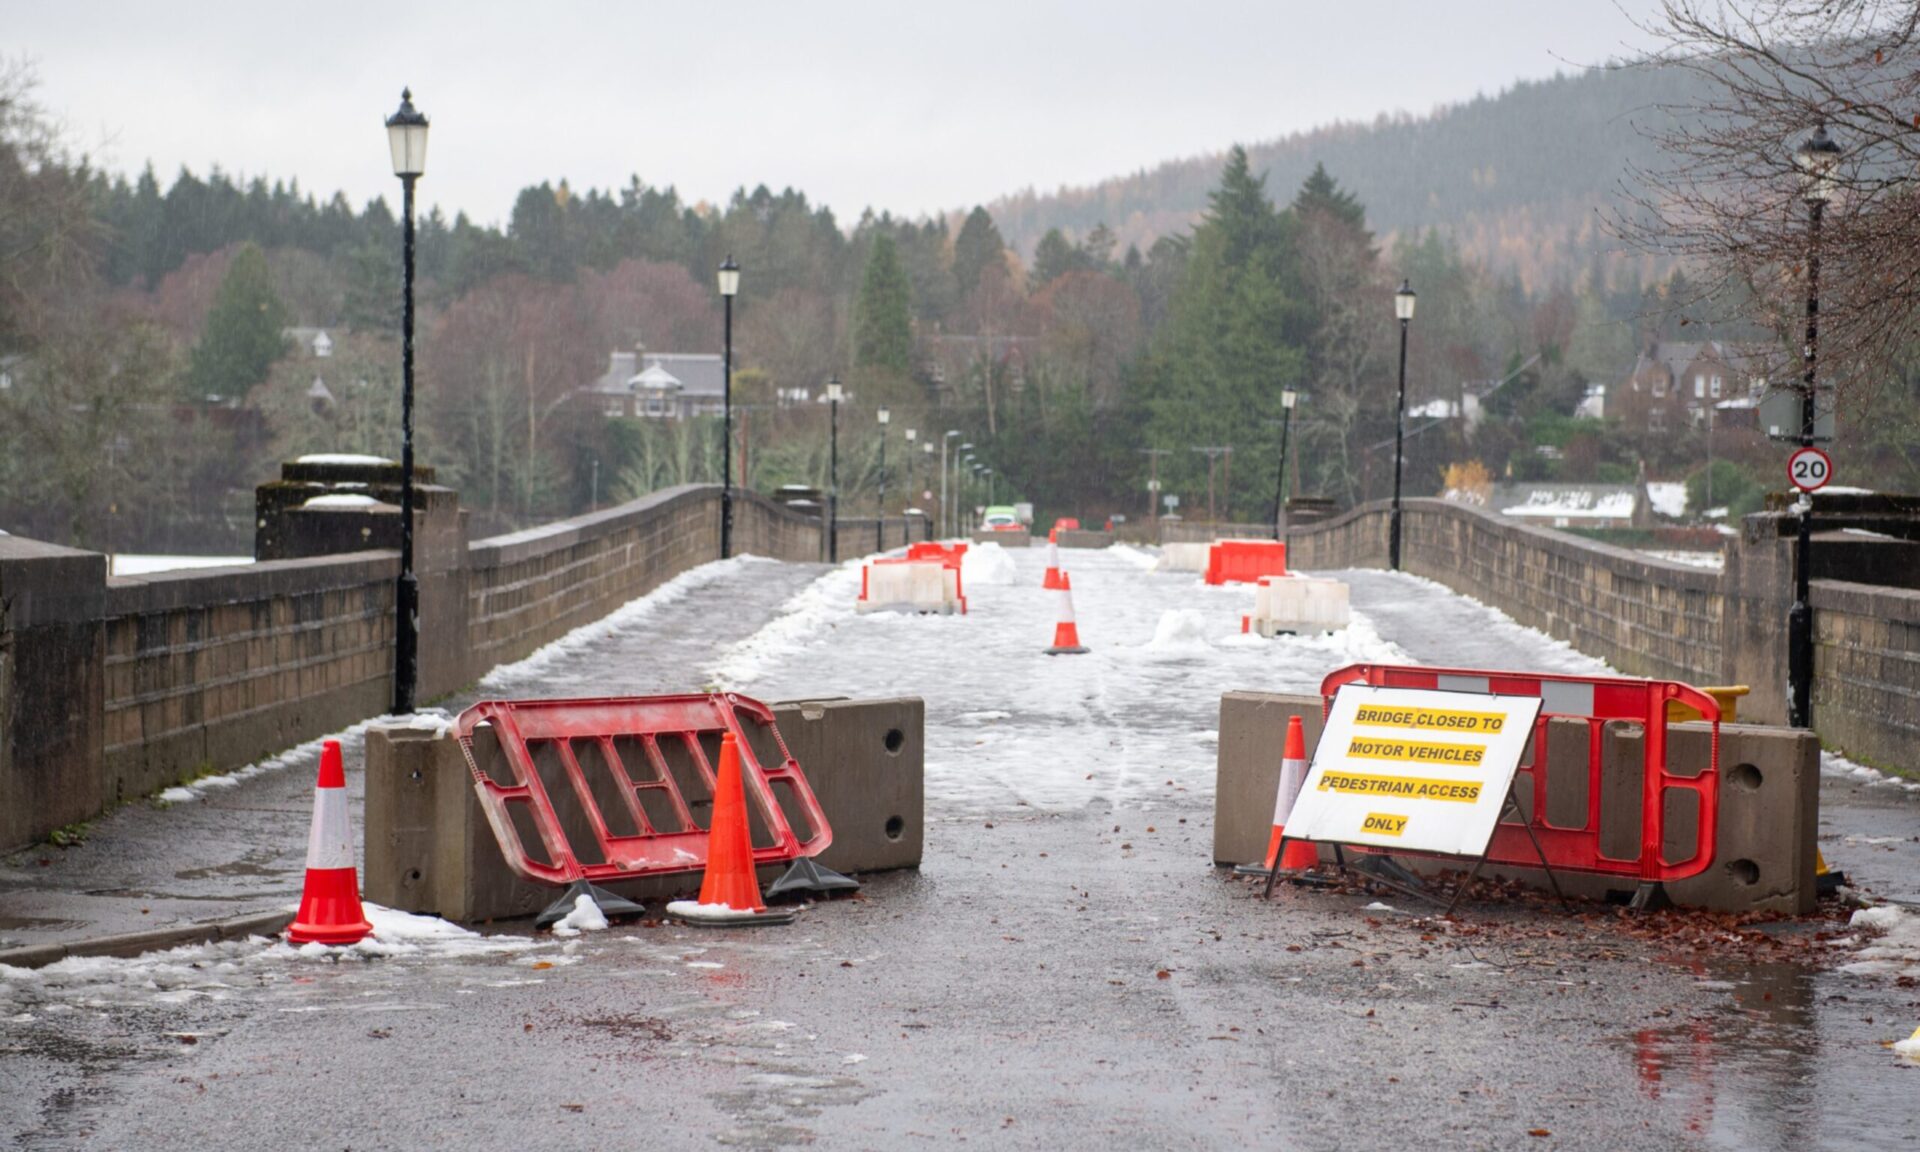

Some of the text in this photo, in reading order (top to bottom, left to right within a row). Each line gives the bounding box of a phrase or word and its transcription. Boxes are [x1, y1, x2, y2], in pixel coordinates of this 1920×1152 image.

[1795, 461, 1825, 478] 20
[1356, 709, 1502, 730] BRIDGE CLOSED TO
[1348, 742, 1483, 762] MOTOR VEHICLES
[1319, 776, 1479, 799] PEDESTRIAN ACCESS
[1363, 817, 1406, 832] ONLY
